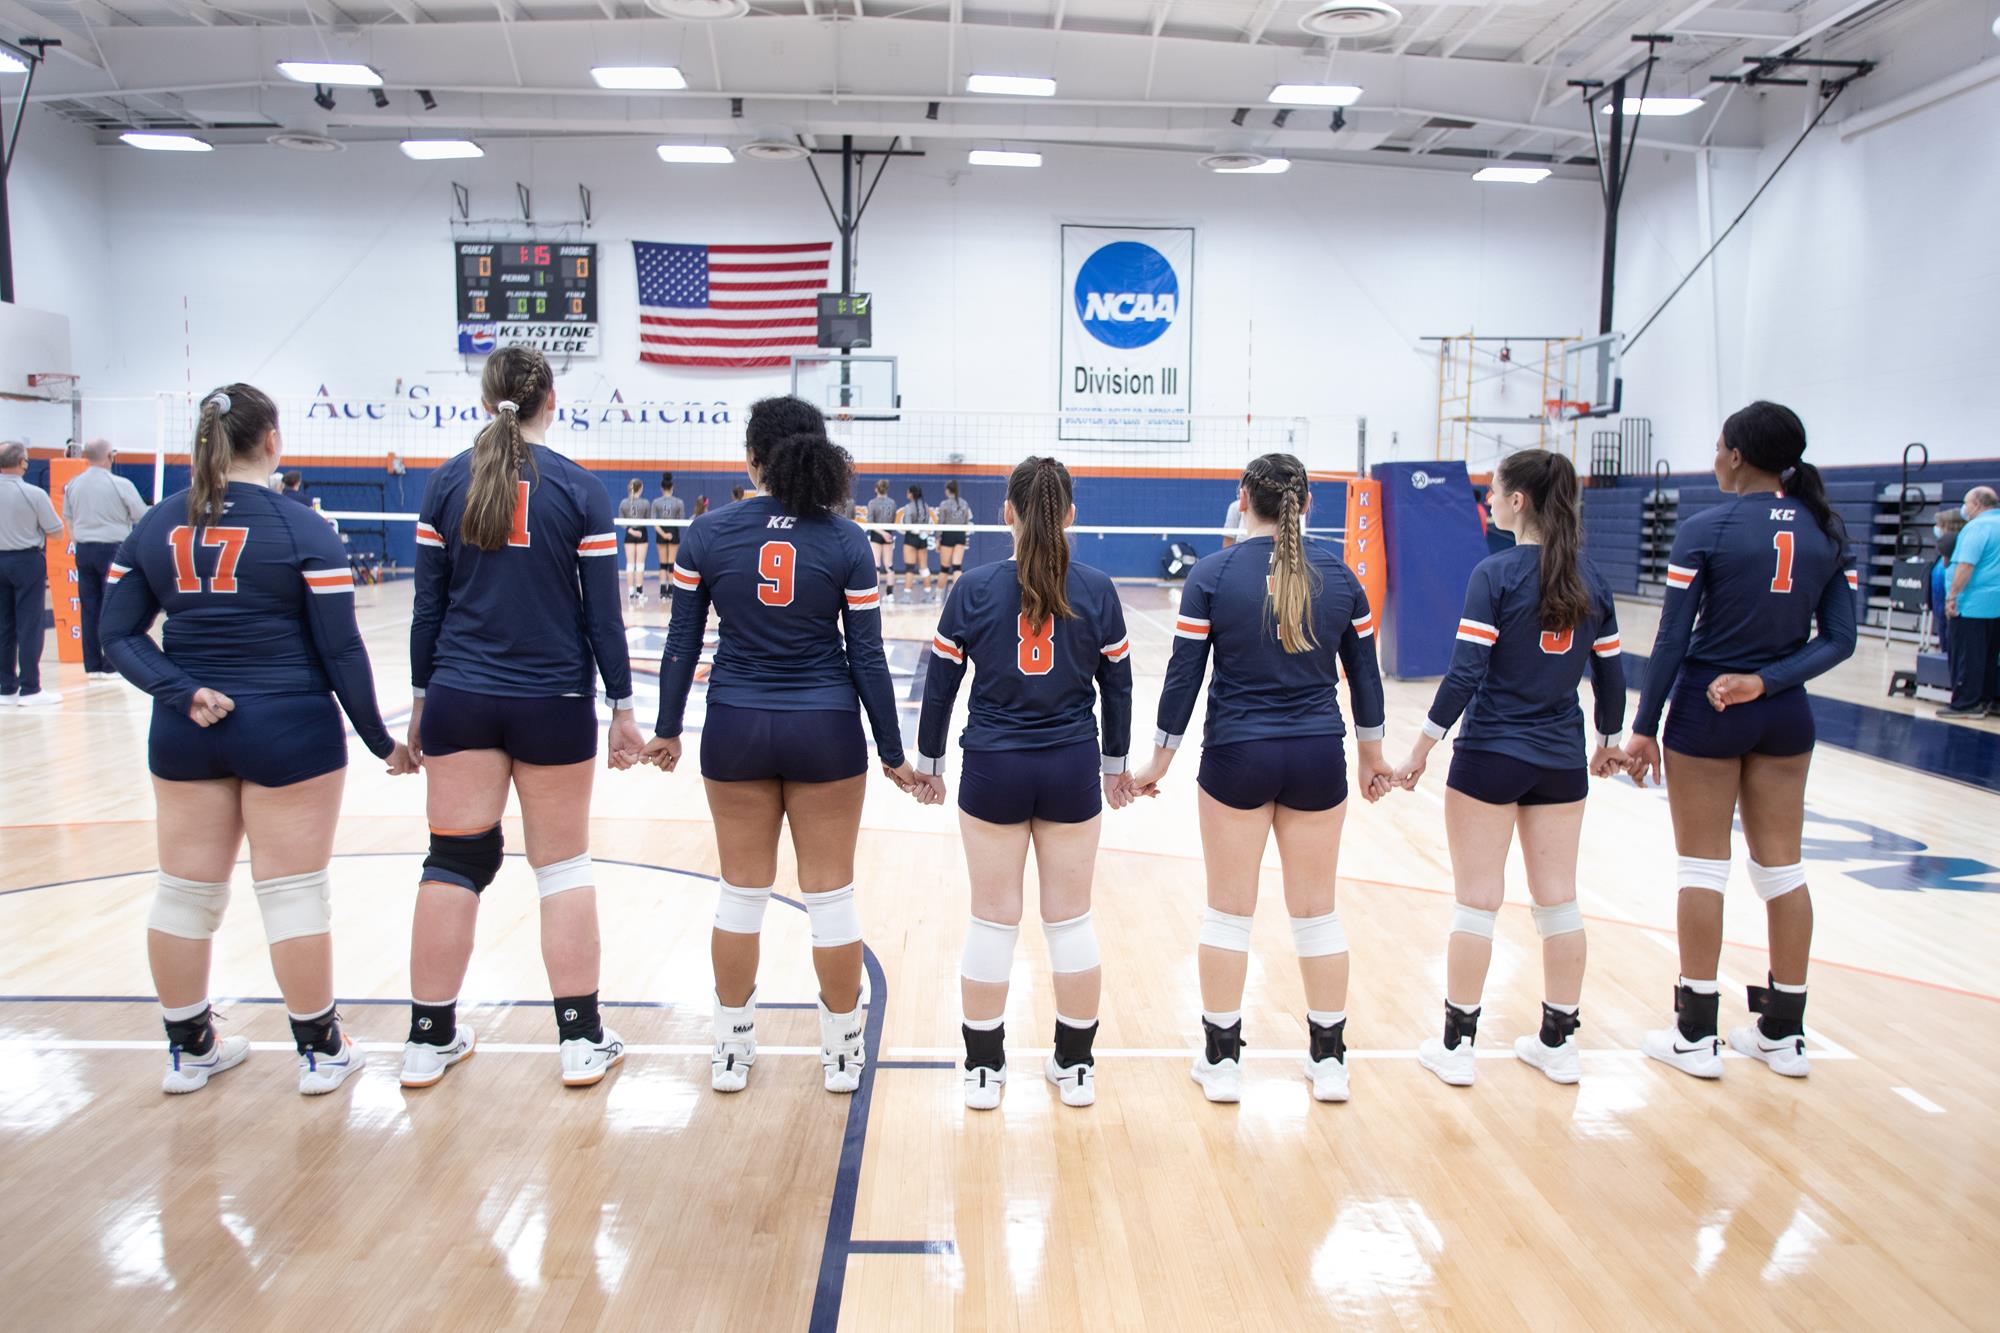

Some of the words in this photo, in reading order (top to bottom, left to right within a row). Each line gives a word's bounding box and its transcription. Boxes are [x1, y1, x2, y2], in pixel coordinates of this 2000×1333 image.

[461, 245, 494, 255] GUEST
[560, 246, 590, 256] HOME
[479, 255, 491, 277] 0
[575, 257, 589, 278] 0
[501, 273, 531, 283] PERIOD
[1083, 292, 1176, 323] NCAA
[500, 325, 595, 338] KEYSTONE
[1074, 366, 1154, 395] Division
[1161, 367, 1177, 395] III
[766, 515, 798, 530] KC
[1769, 507, 1797, 521] KC
[1357, 492, 1370, 592] KEYS
[168, 524, 250, 594] 17
[1769, 530, 1795, 594] 1
[757, 540, 797, 608] 9
[1017, 611, 1055, 676] 8
